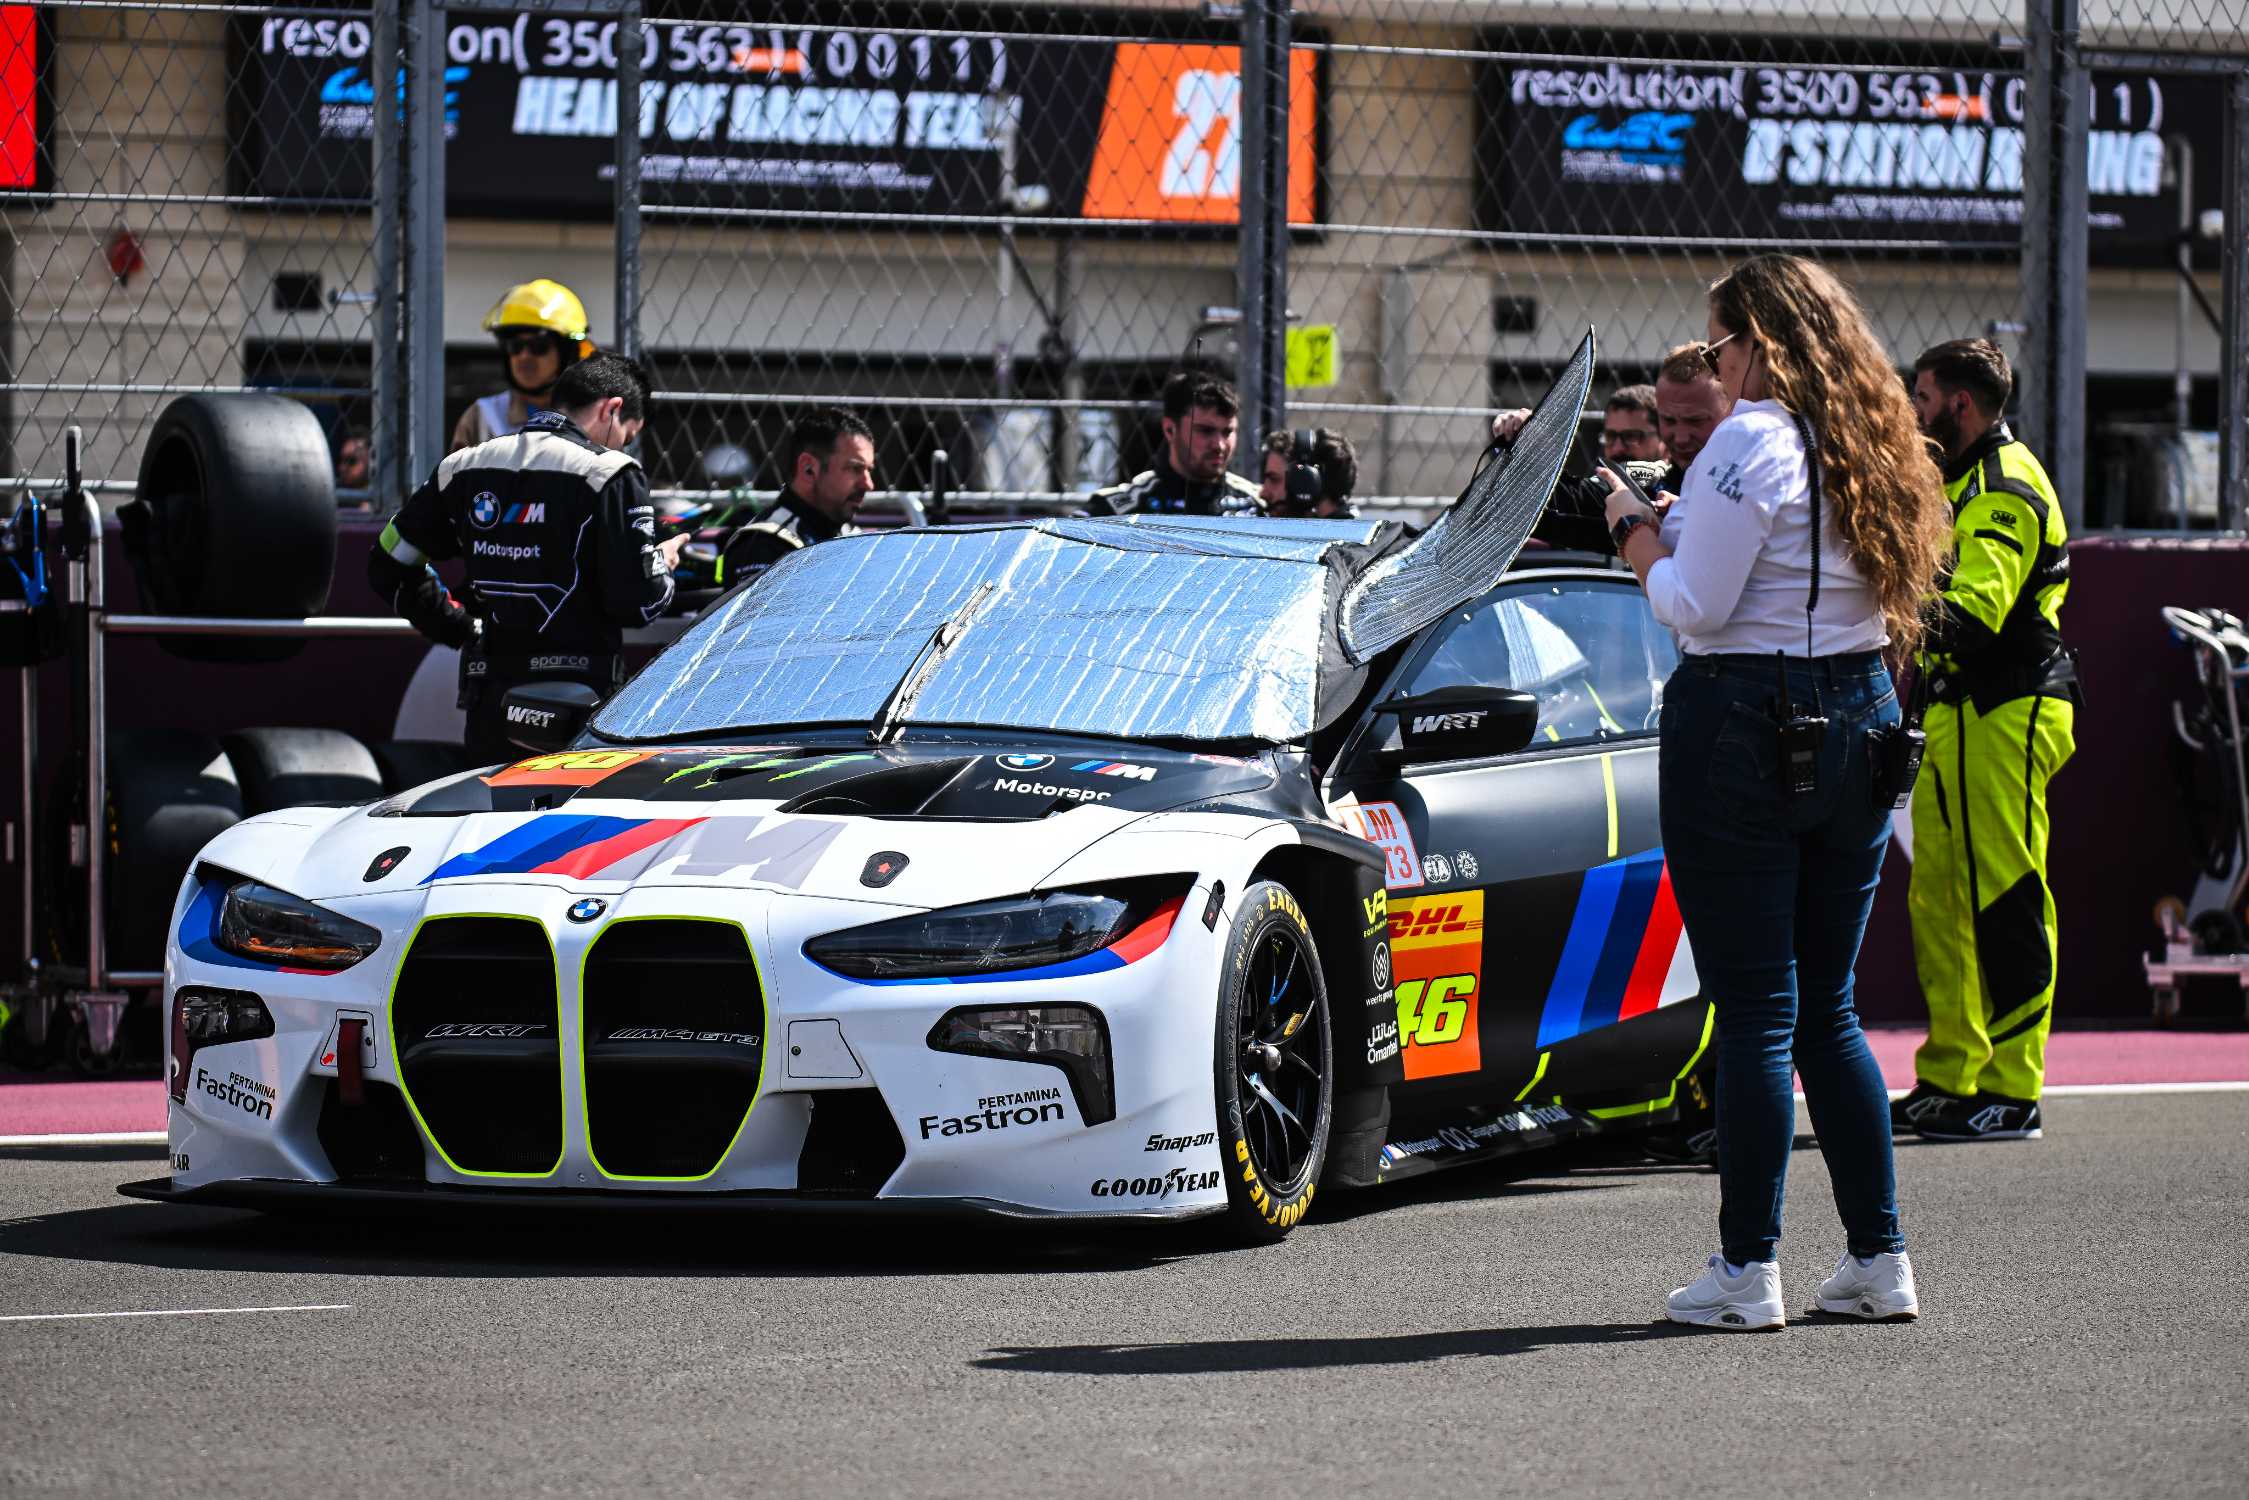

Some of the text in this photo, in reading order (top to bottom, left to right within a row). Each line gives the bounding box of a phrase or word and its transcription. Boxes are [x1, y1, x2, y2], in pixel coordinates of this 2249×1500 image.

[262, 13, 529, 72] resoon(
[664, 80, 731, 142] OF
[1985, 126, 2165, 197] RING
[473, 540, 541, 560] Motorsport
[505, 705, 556, 728] WRT
[1411, 710, 1489, 734] WRT
[993, 778, 1112, 801] Motorspo
[1383, 846, 1413, 880] T3
[1387, 904, 1470, 938] DHL
[1395, 973, 1477, 1048] 46
[196, 1068, 273, 1121] Fastron
[229, 1071, 276, 1101] PERTAMINA
[978, 1086, 1062, 1110] PERTAMINA
[919, 1102, 1065, 1140] Fastron
[1143, 1132, 1216, 1153] Snap-on
[1091, 1167, 1220, 1200] GOODYEAR
